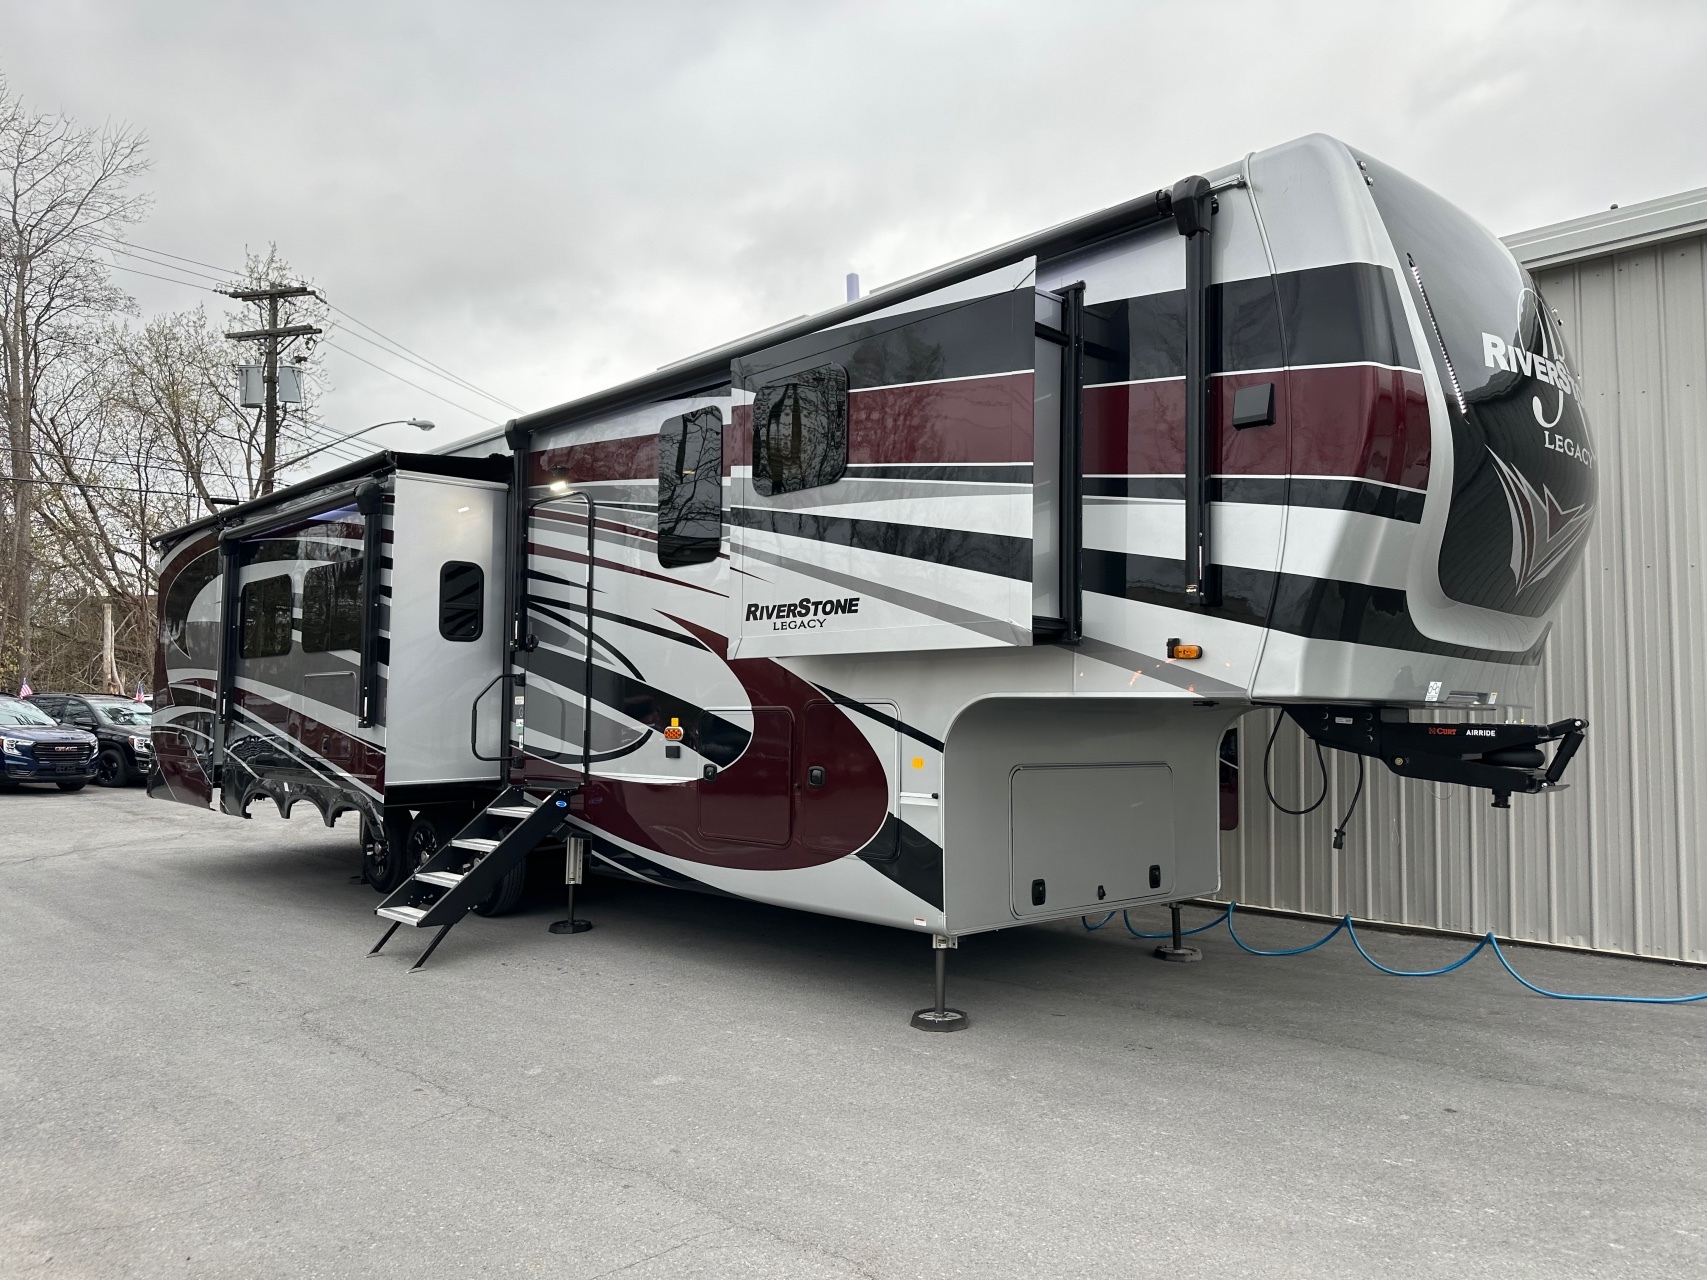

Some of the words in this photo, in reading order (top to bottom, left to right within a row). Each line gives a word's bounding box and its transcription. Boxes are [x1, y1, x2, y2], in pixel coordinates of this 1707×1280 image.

[1543, 430, 1593, 469] LEGACY
[773, 618, 827, 631] LEGACY
[1466, 729, 1496, 737] AIRRIDE
